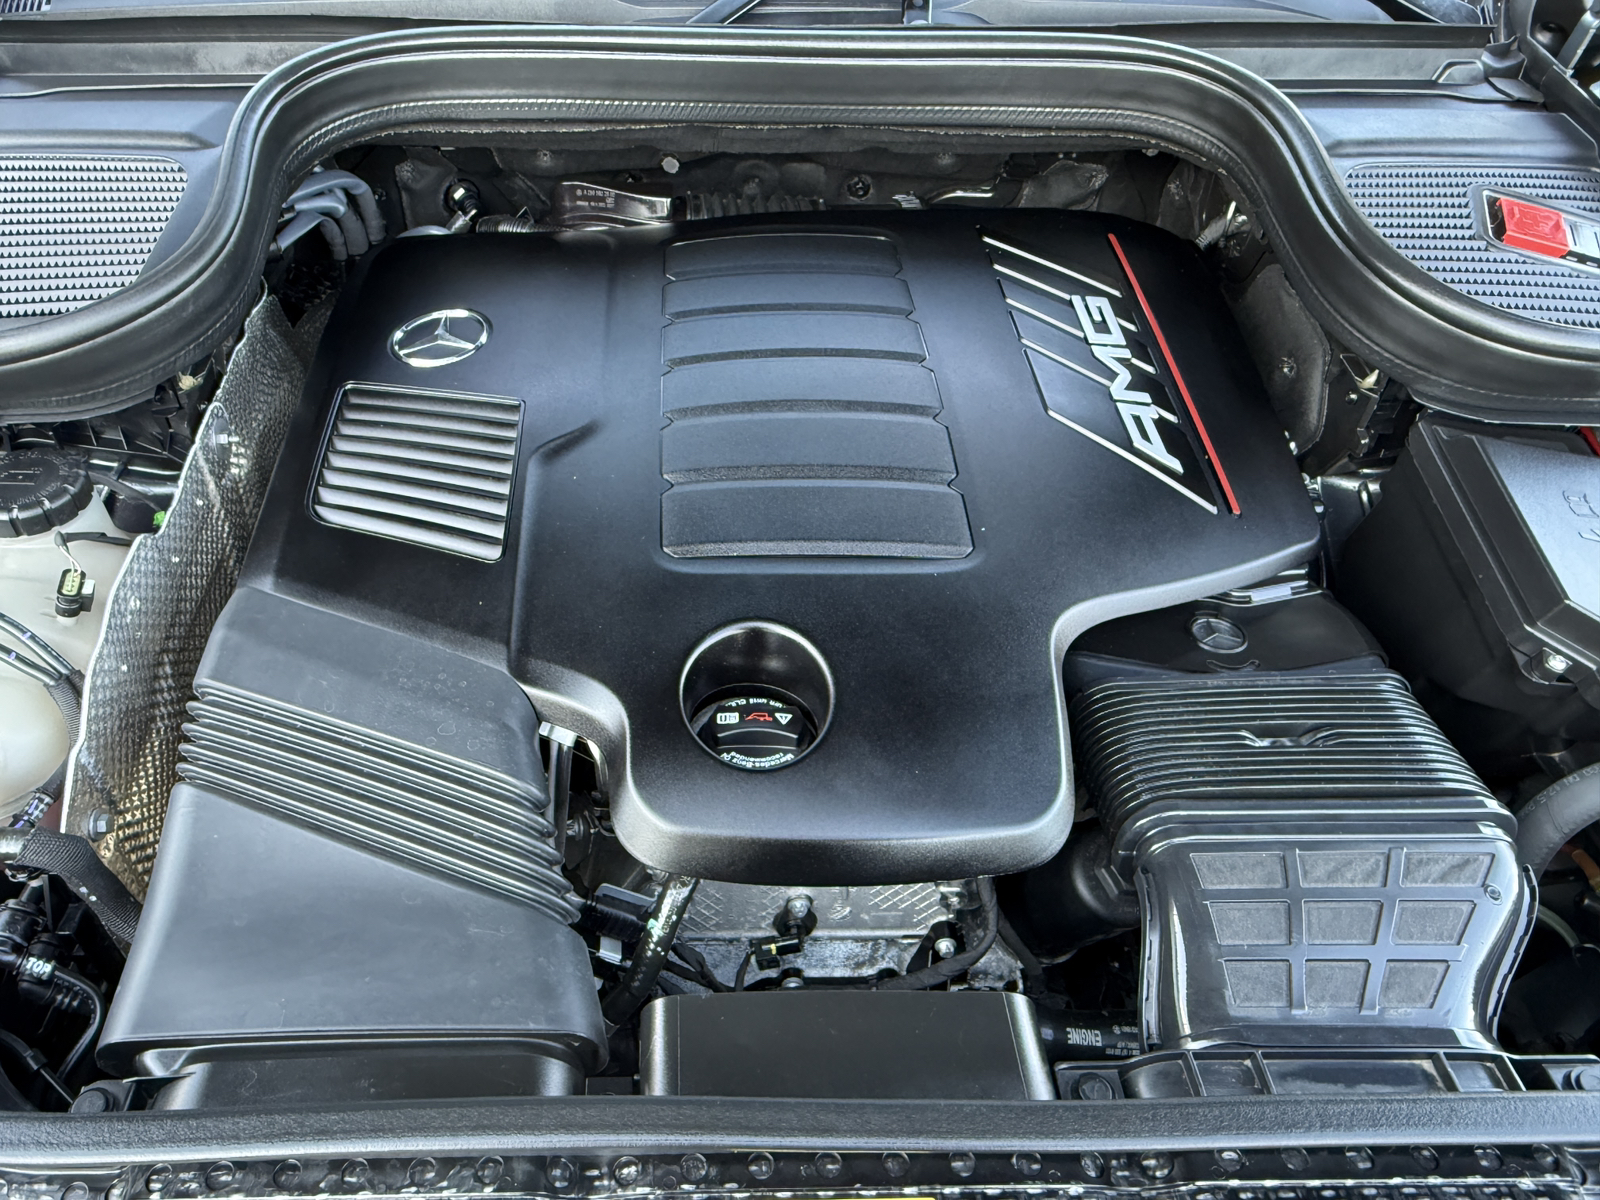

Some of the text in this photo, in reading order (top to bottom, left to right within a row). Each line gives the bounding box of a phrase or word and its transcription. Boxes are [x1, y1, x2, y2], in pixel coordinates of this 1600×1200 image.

[1071, 295, 1184, 475] AMG
[768, 700, 785, 708] urn
[731, 751, 784, 762] recommended
[732, 753, 795, 768] Mercedes-Benz
[26, 957, 52, 975] TOP
[1066, 1028, 1102, 1047] ENGINE
